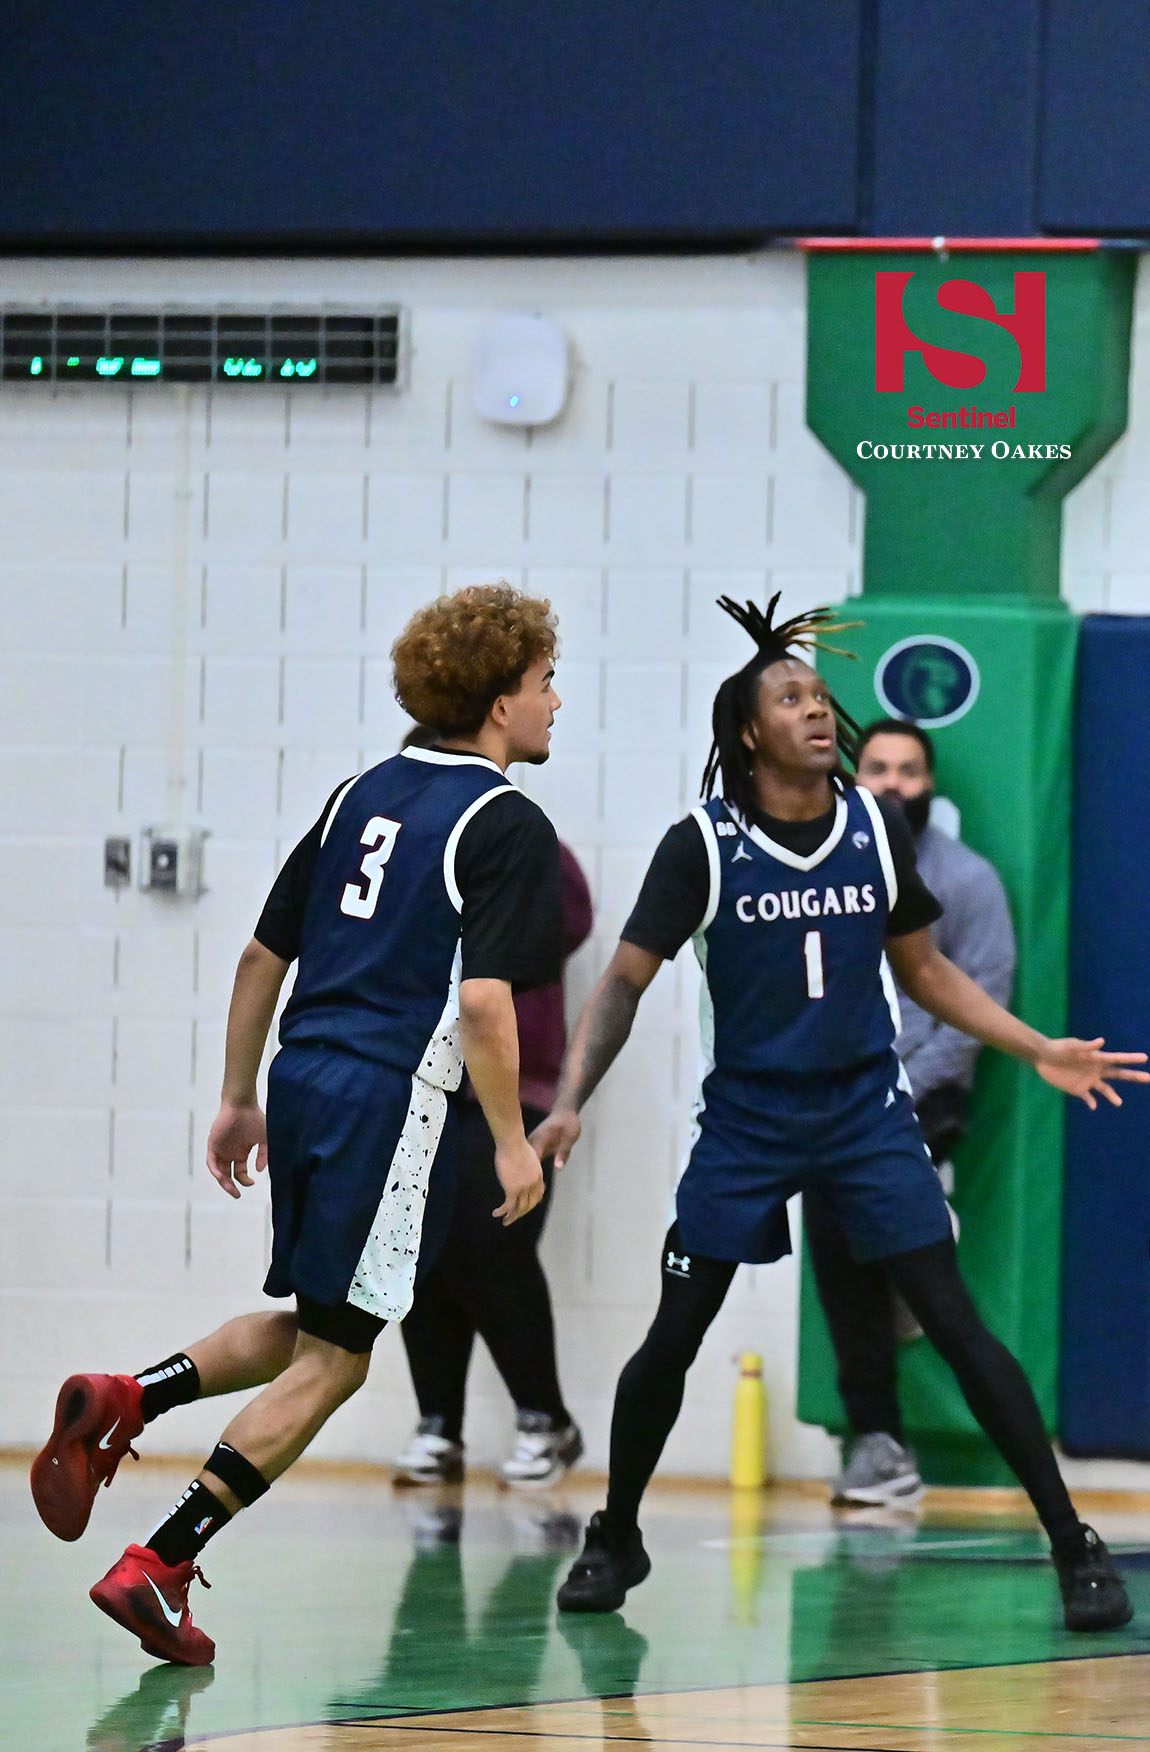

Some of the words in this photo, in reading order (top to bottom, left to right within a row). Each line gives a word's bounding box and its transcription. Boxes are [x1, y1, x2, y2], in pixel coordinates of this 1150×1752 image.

[340, 815, 402, 920] 3
[735, 884, 876, 923] COUGARS
[804, 930, 824, 999] 1
